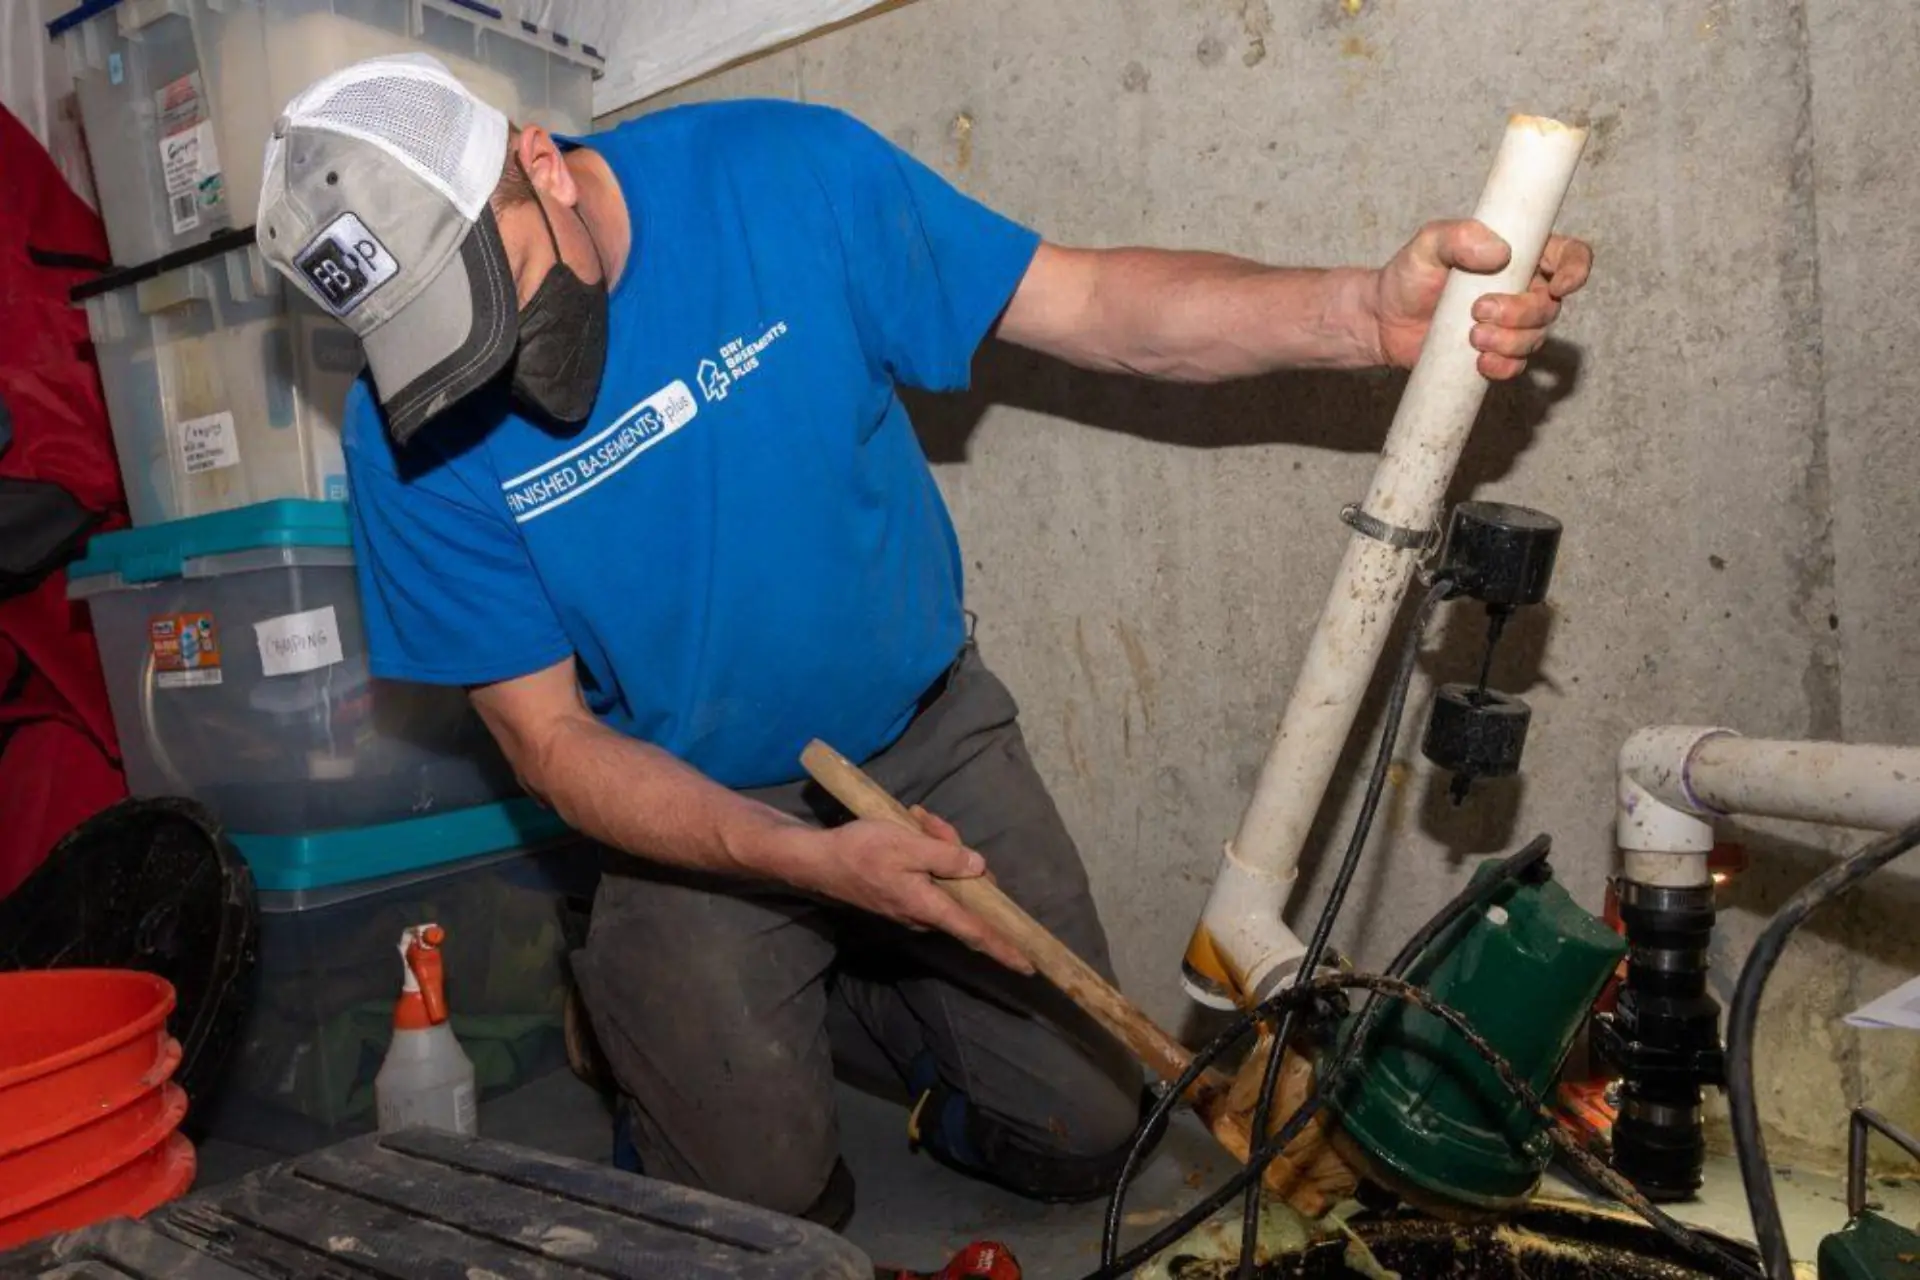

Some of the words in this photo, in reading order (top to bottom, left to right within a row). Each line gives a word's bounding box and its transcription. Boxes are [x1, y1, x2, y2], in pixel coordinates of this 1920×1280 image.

[719, 337, 743, 358] DRY
[725, 321, 788, 369] BASEMENTS
[731, 357, 760, 381] PLUS
[506, 466, 577, 512] FINISHED
[577, 411, 660, 479] BASEMENTS
[664, 395, 690, 424] plus
